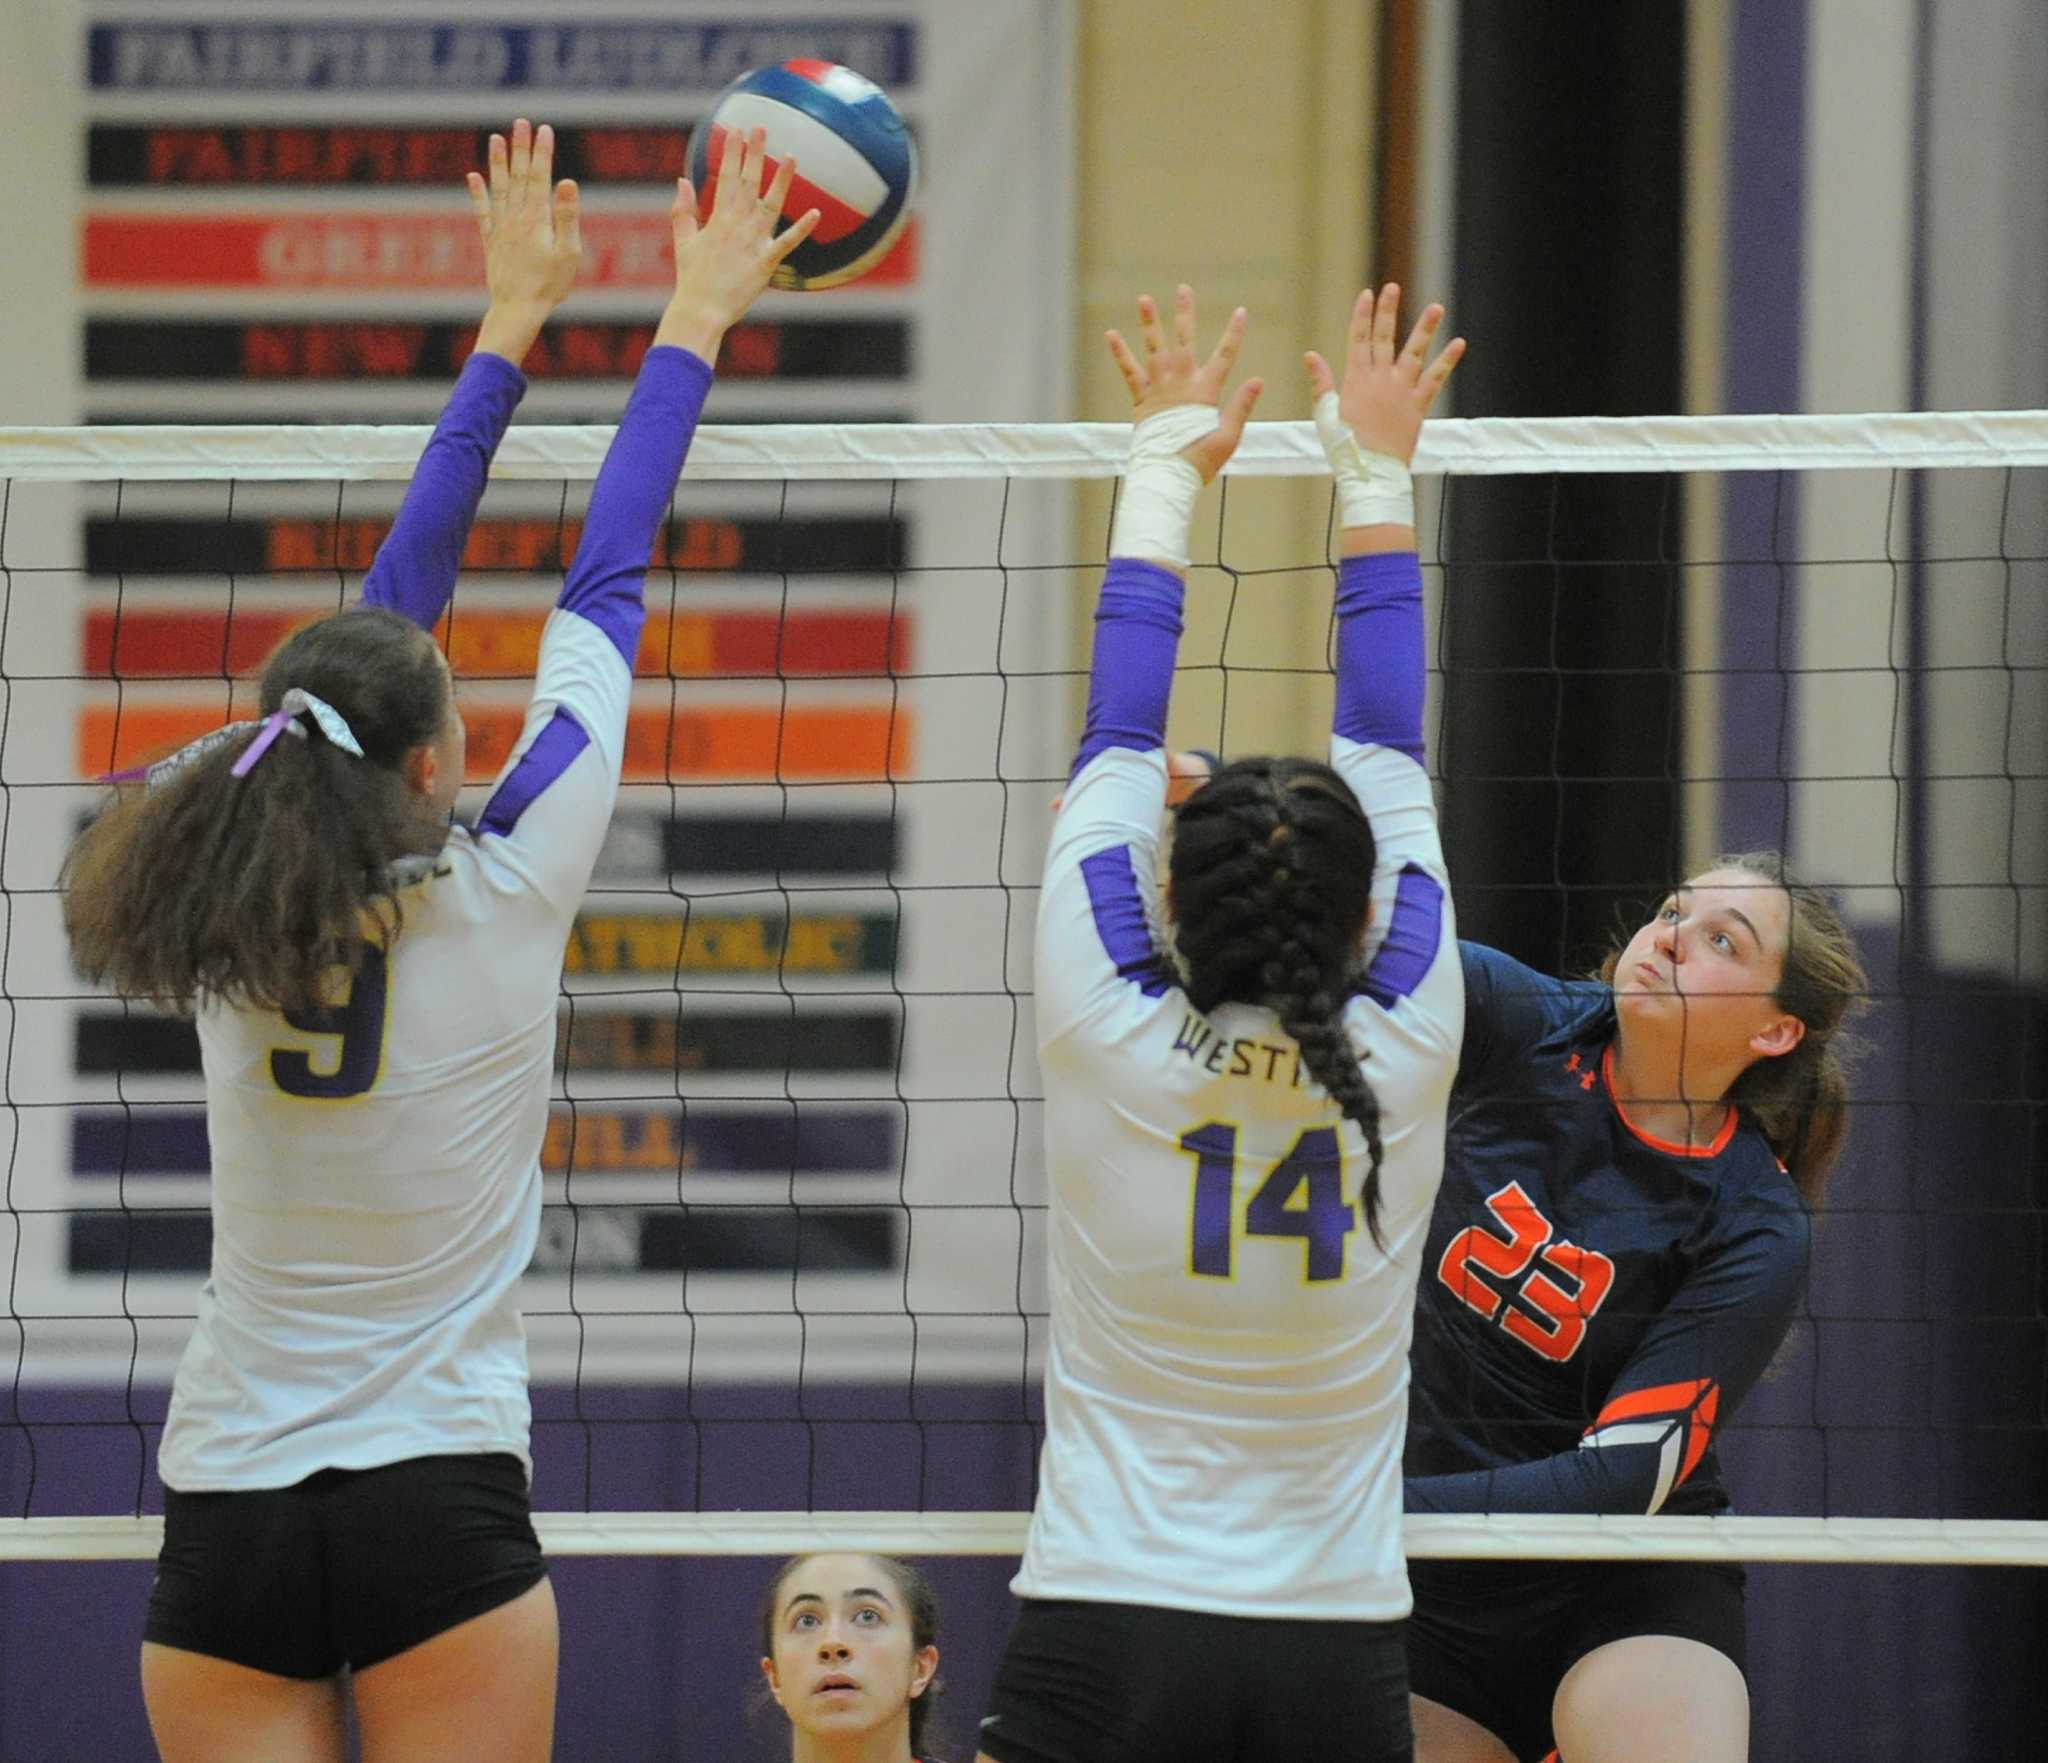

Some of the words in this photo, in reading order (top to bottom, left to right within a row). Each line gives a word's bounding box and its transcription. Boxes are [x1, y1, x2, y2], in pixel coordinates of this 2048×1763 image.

[264, 928, 395, 1103] 9
[1173, 1012, 1371, 1088] WEST
[1175, 1117, 1360, 1288] 14
[1438, 1180, 1615, 1363] 23
